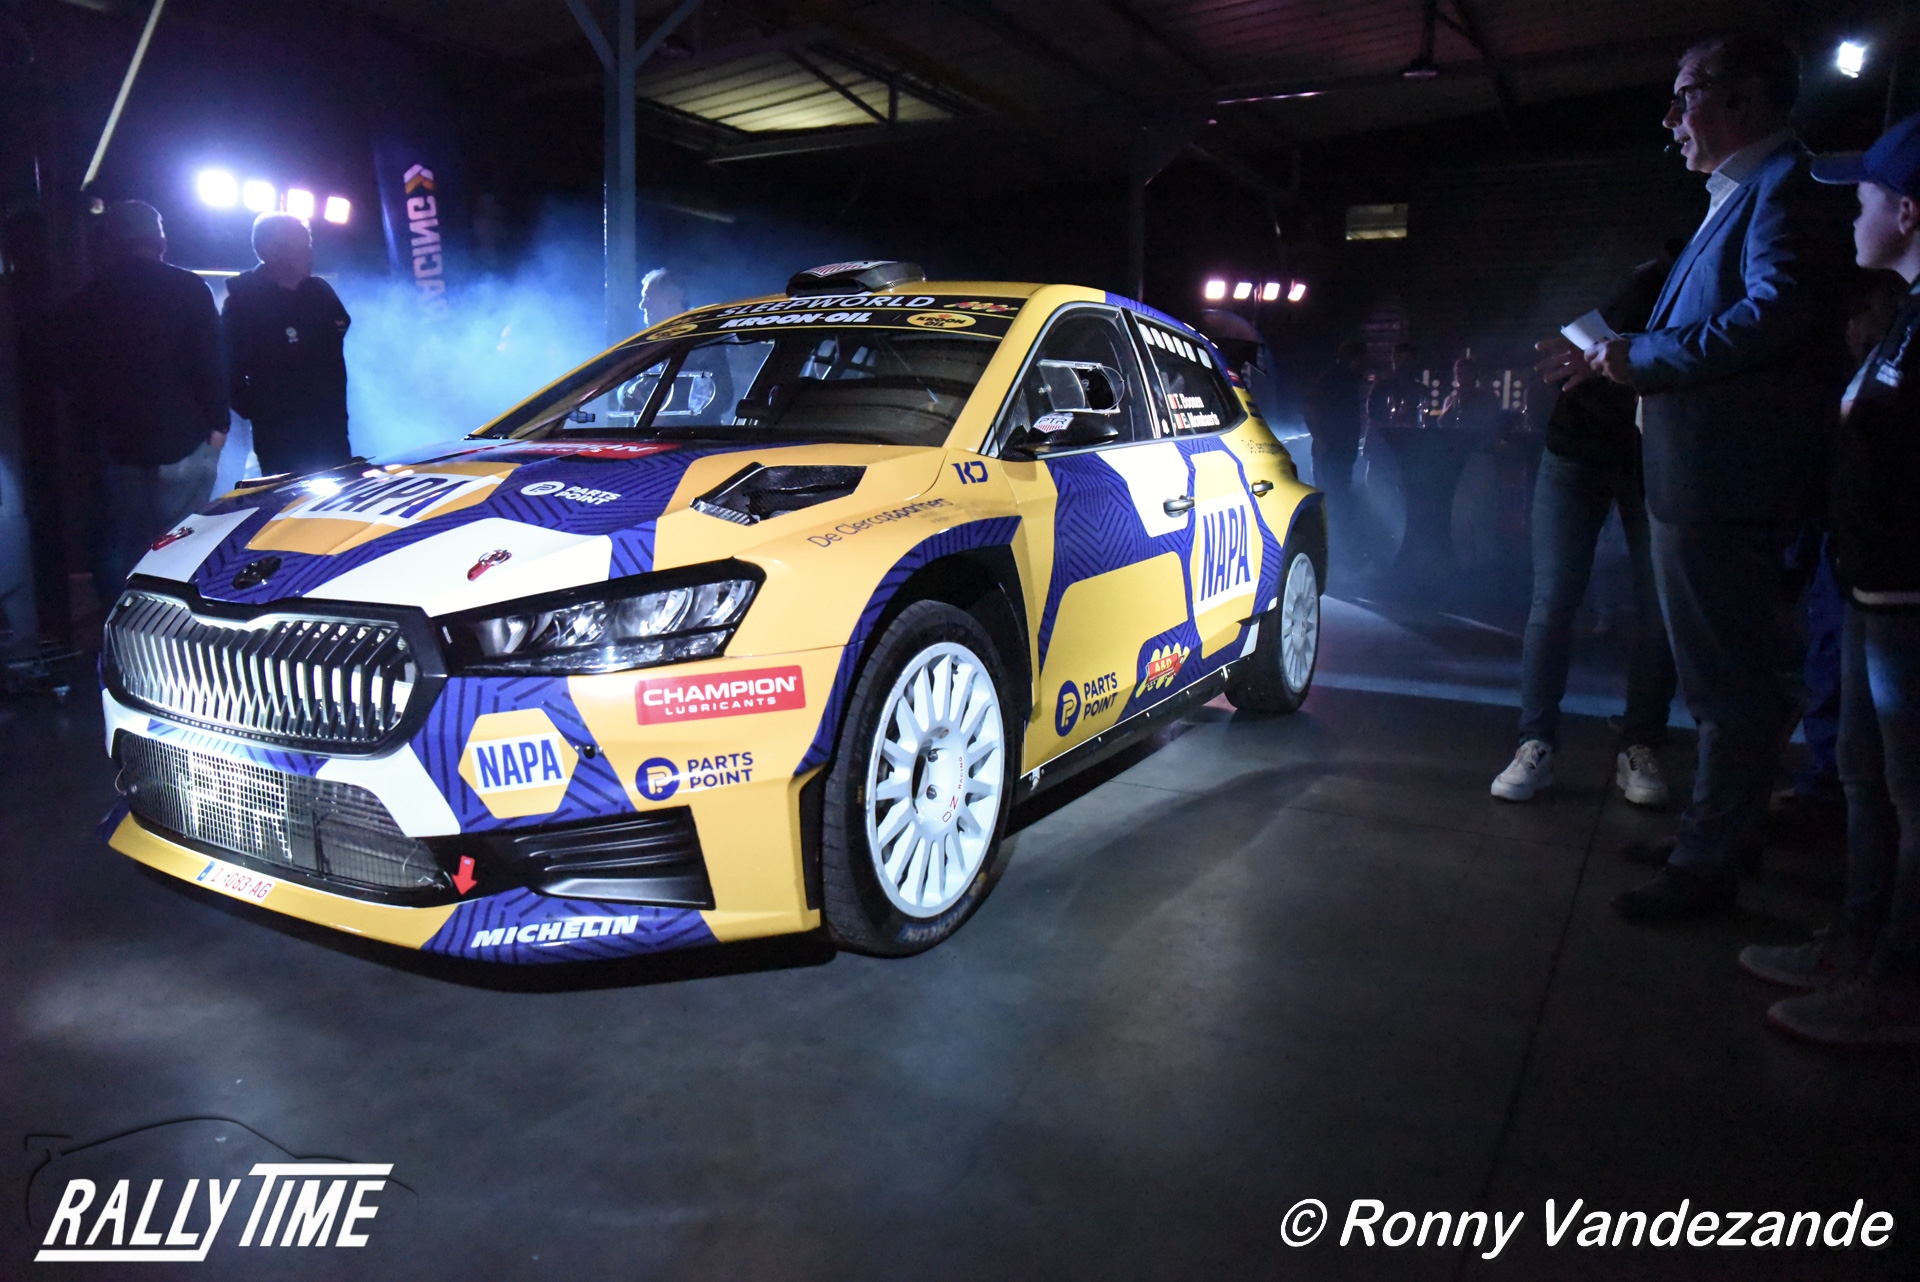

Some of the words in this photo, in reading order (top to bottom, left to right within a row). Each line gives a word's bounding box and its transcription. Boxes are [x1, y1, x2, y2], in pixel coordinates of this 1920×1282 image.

[717, 295, 936, 317] SLEEPWORLD
[718, 312, 873, 329] KROON-OIL
[915, 316, 967, 325] KROON
[1038, 417, 1068, 425] PTR
[554, 491, 610, 505] POINT
[565, 485, 622, 501] PARTS
[807, 532, 843, 548] De
[1200, 504, 1251, 602] NAPA
[1155, 657, 1172, 673] A&D
[643, 675, 796, 706] CHAMPION
[1083, 671, 1118, 701] PARTS
[665, 696, 777, 716] LUBRICANTS
[1083, 691, 1119, 721] POINT
[476, 738, 563, 789] NAPA
[687, 751, 754, 773] PARTS
[689, 768, 753, 789] POINT
[470, 914, 639, 948] MICHELIN
